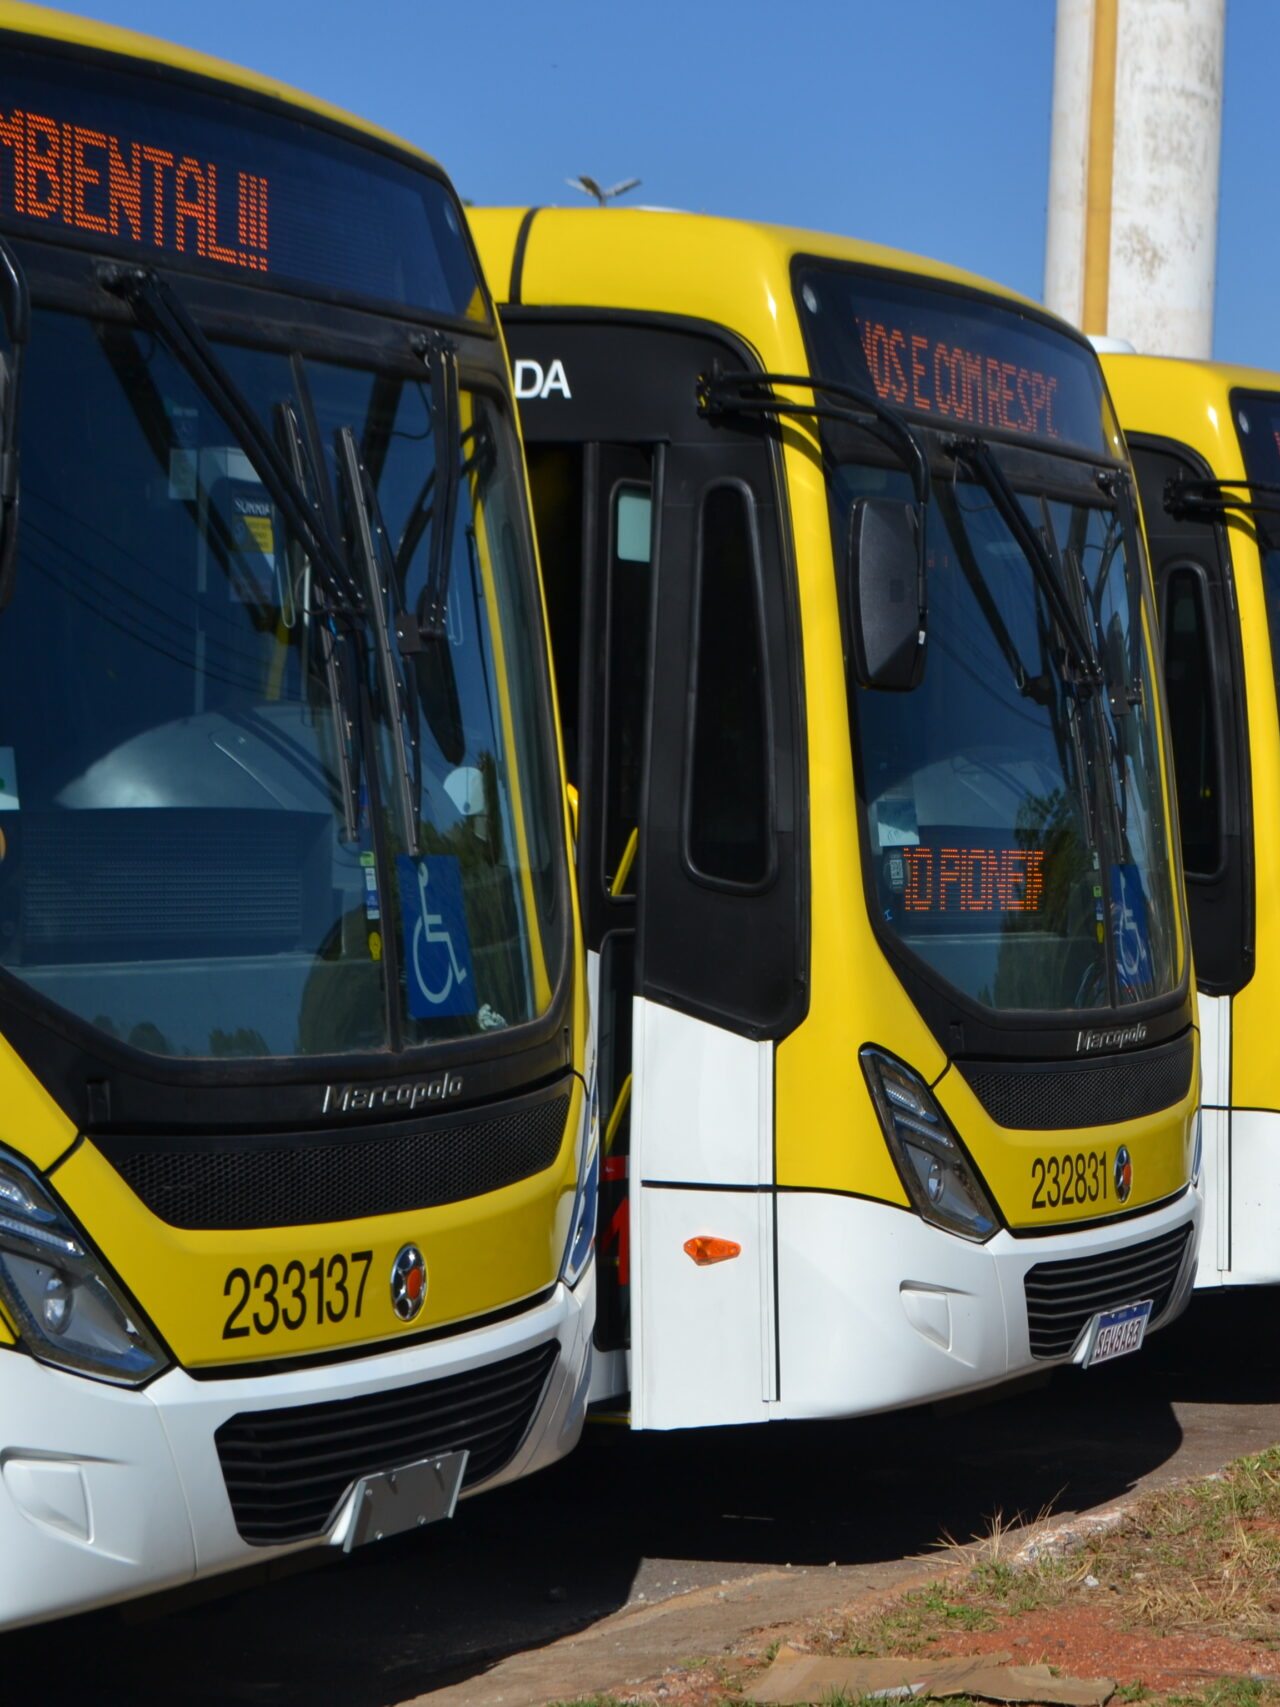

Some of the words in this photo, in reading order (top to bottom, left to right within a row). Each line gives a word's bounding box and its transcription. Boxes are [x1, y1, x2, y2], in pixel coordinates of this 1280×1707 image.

[514, 358, 572, 400] DA
[911, 335, 931, 410] E
[934, 342, 984, 424] COM
[1076, 1022, 1148, 1052] Marcopolo
[322, 1071, 464, 1114] Marcopolo
[1031, 1151, 1108, 1210] 232831
[222, 1251, 373, 1340] 233137
